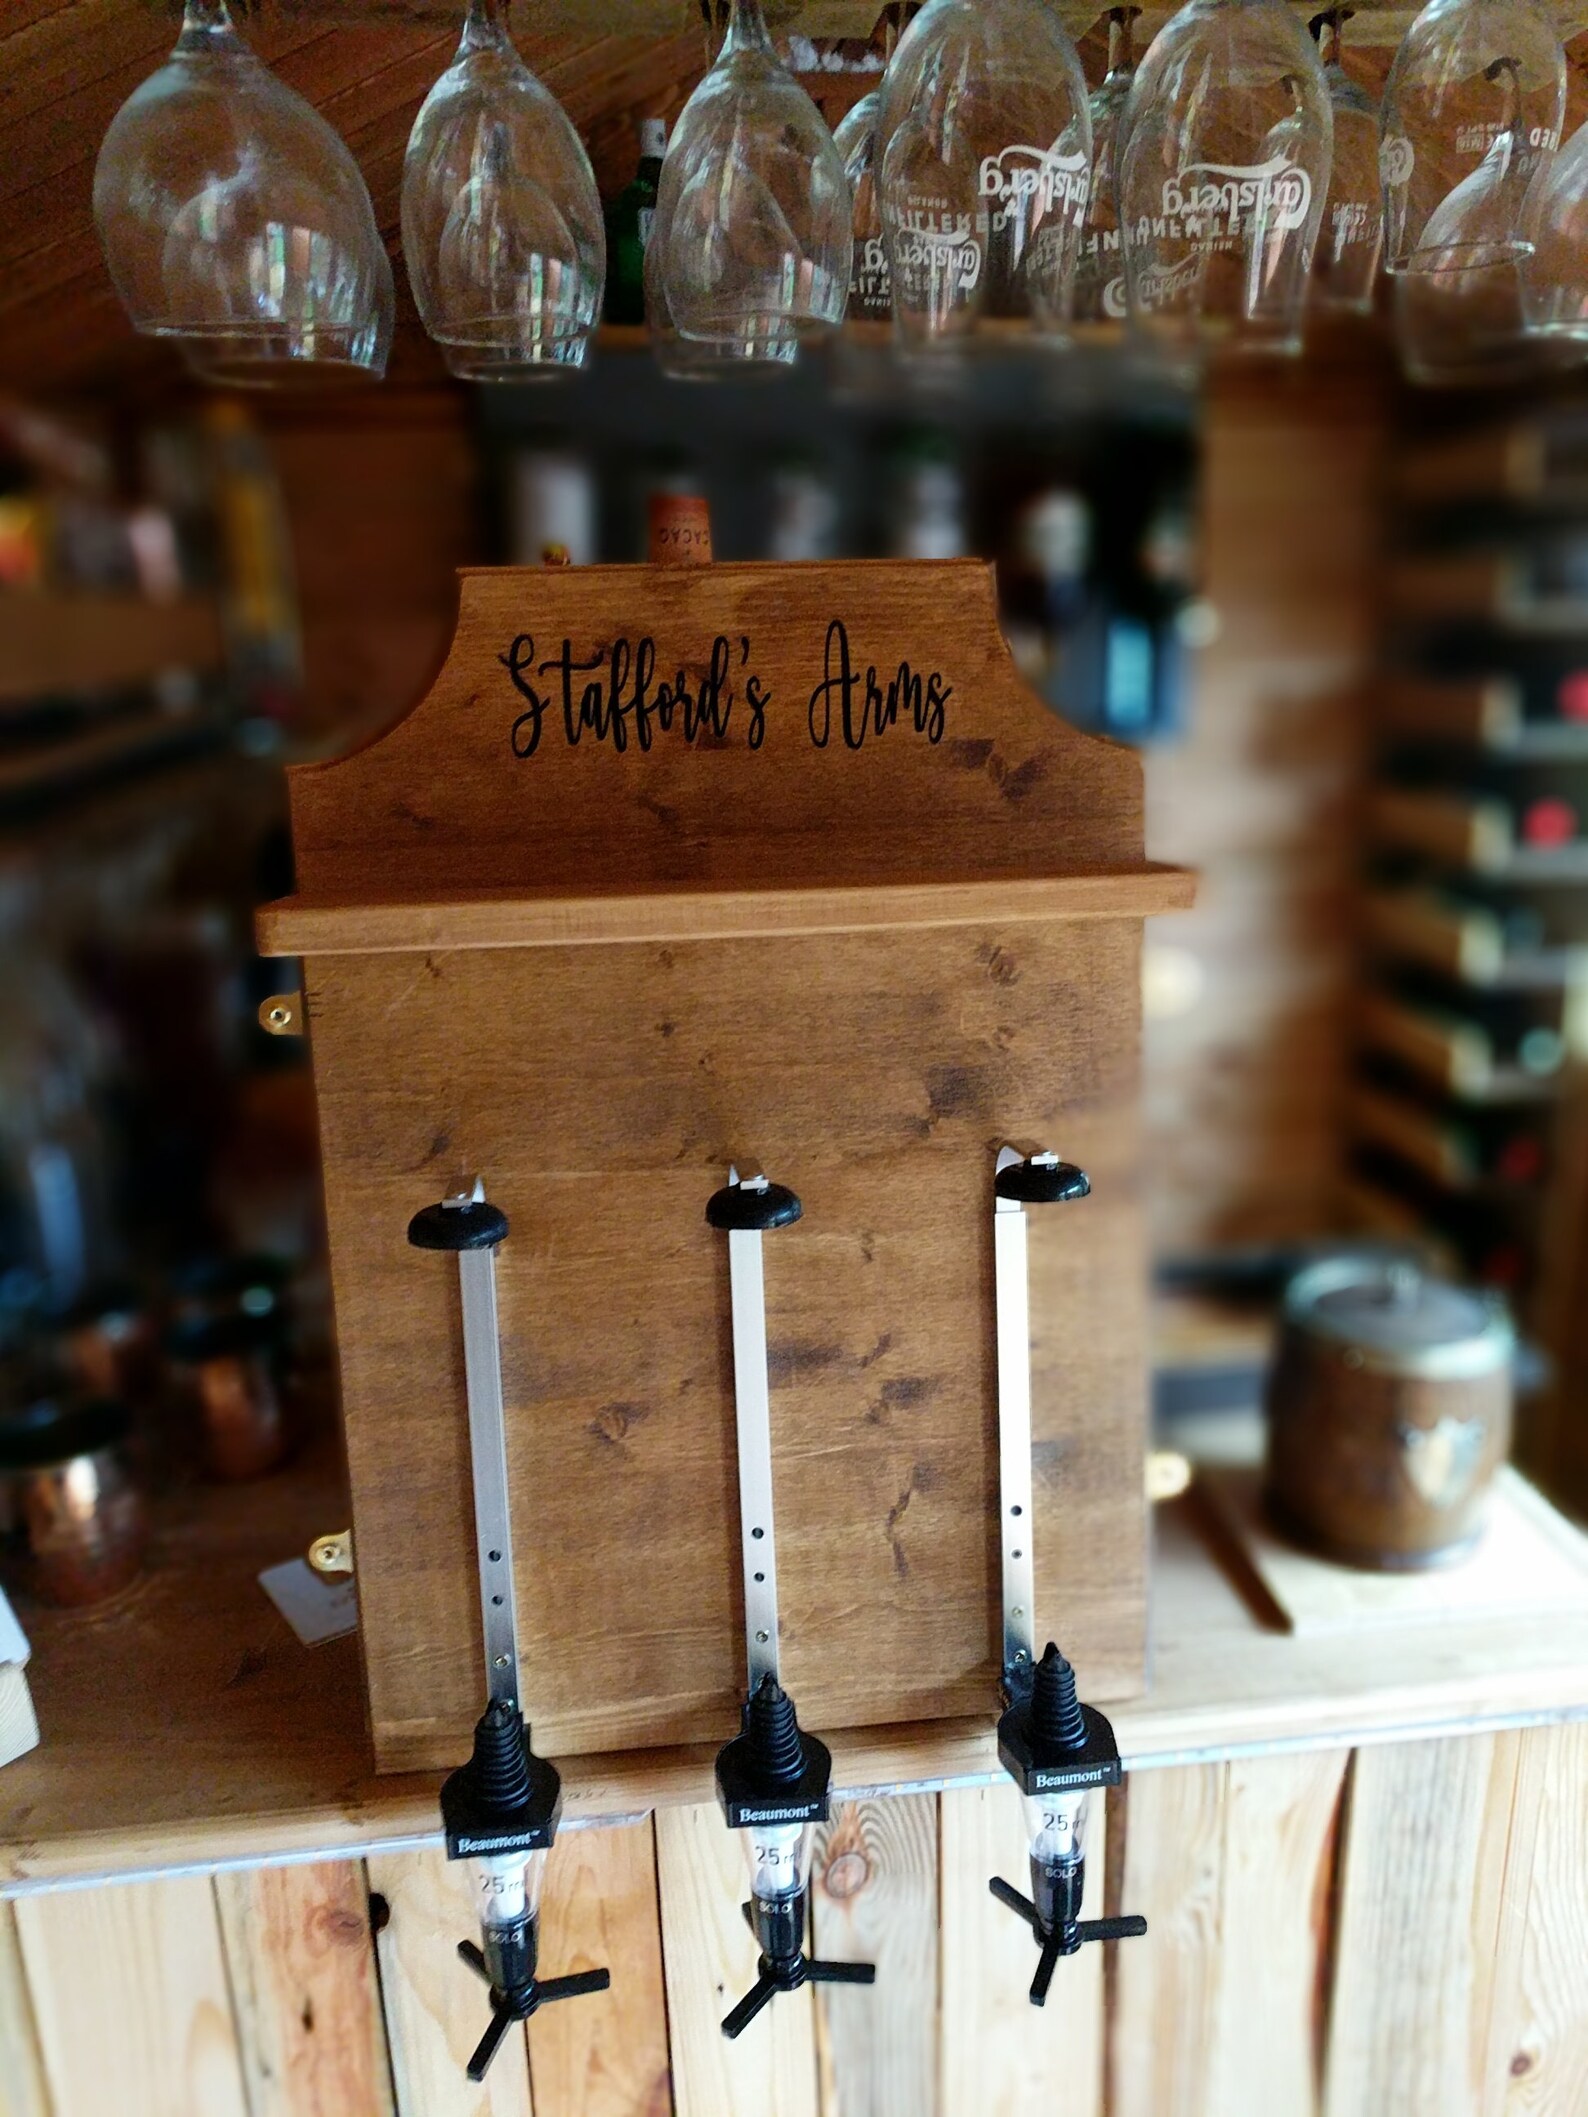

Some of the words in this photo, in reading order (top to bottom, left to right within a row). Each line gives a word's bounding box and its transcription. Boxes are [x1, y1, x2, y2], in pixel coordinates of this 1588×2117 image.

[1162, 155, 1311, 230] Carlsberg
[500, 634, 771, 758] Stafford's
[809, 619, 952, 747] Arms
[1043, 1812, 1068, 1831] 25
[755, 1845, 780, 1866] 25
[479, 1874, 505, 1894] 25
